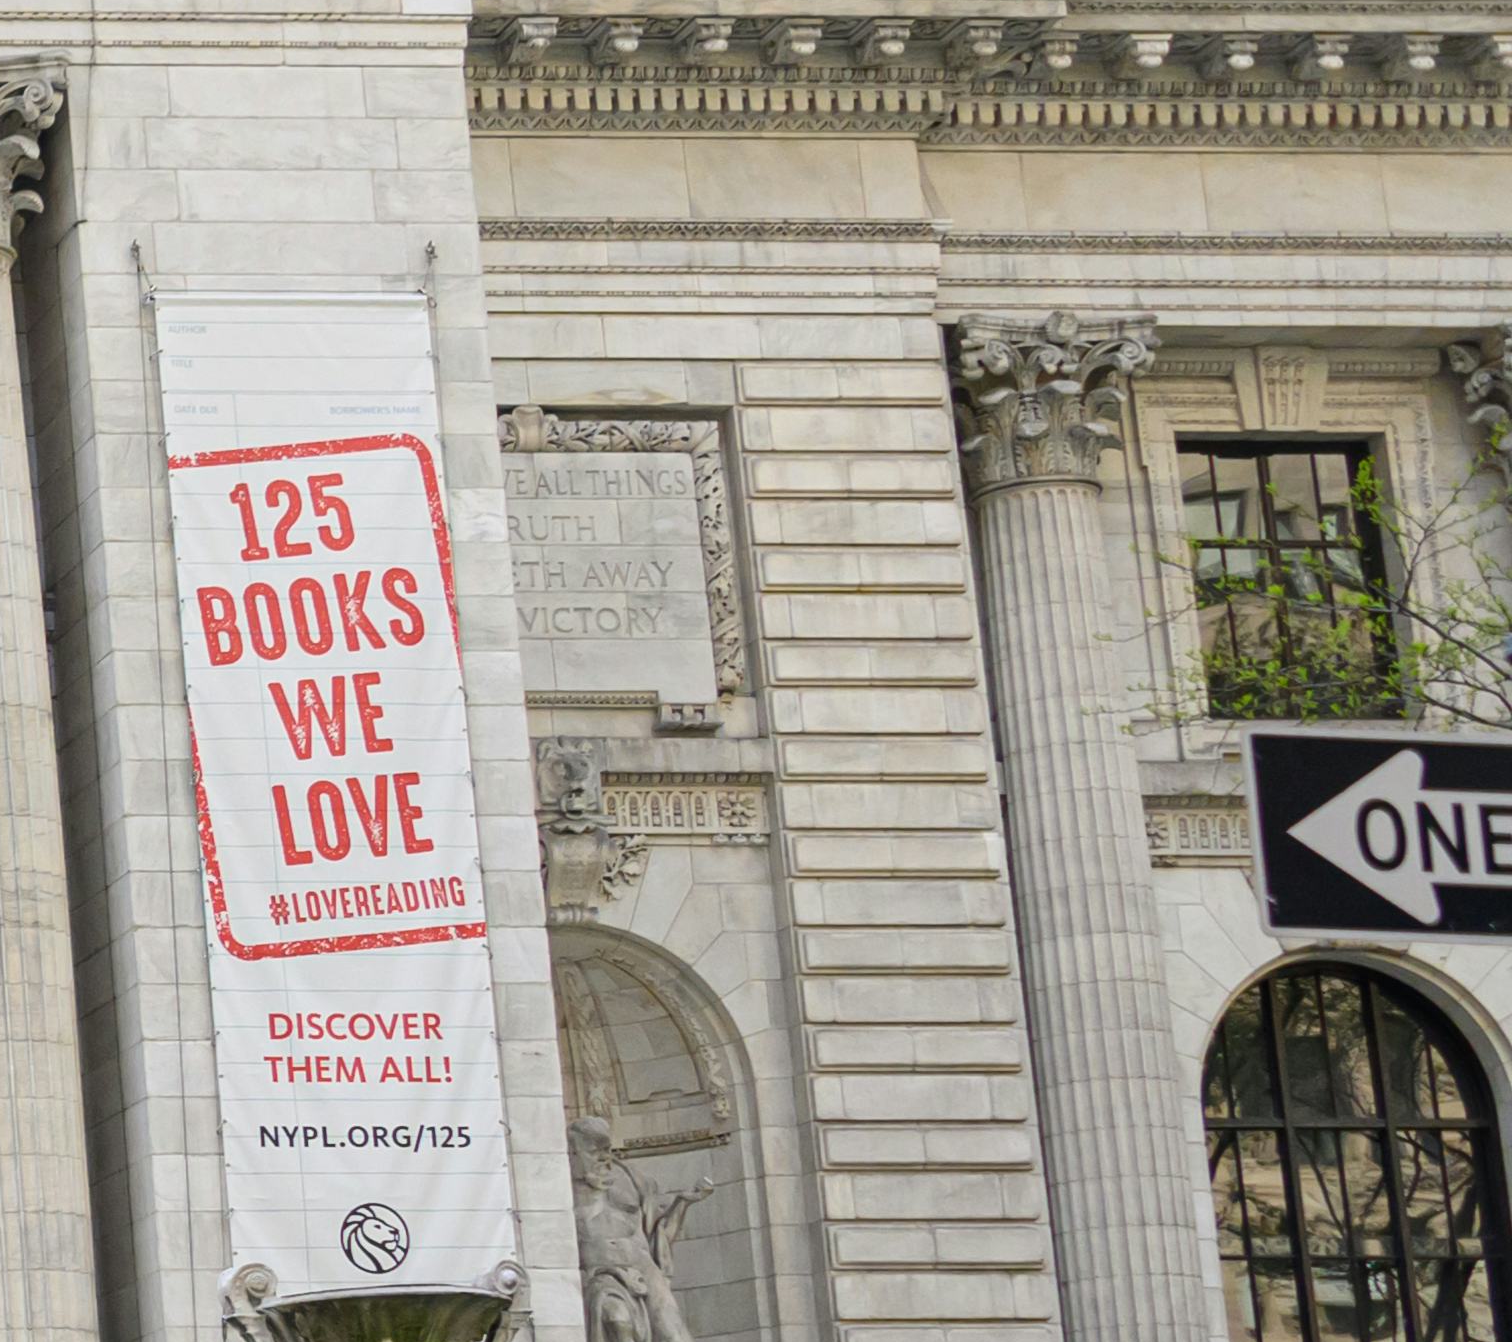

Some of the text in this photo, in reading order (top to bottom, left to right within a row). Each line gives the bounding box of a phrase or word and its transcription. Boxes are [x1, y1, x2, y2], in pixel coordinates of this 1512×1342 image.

[536, 470, 688, 496] ALL THINGS
[229, 474, 356, 563] 125
[583, 562, 673, 587] AWAY
[198, 567, 426, 667] BOOKS
[517, 608, 663, 634] VICTORY
[268, 671, 395, 761] WE
[271, 771, 434, 866] LOVE
[1355, 798, 1512, 874] ONE
[268, 876, 467, 925] #LOVEREADING
[268, 1012, 444, 1041] DISCOVER
[263, 1055, 452, 1083] THEM ALL!
[259, 1124, 473, 1153] NYPL.ORG/125
